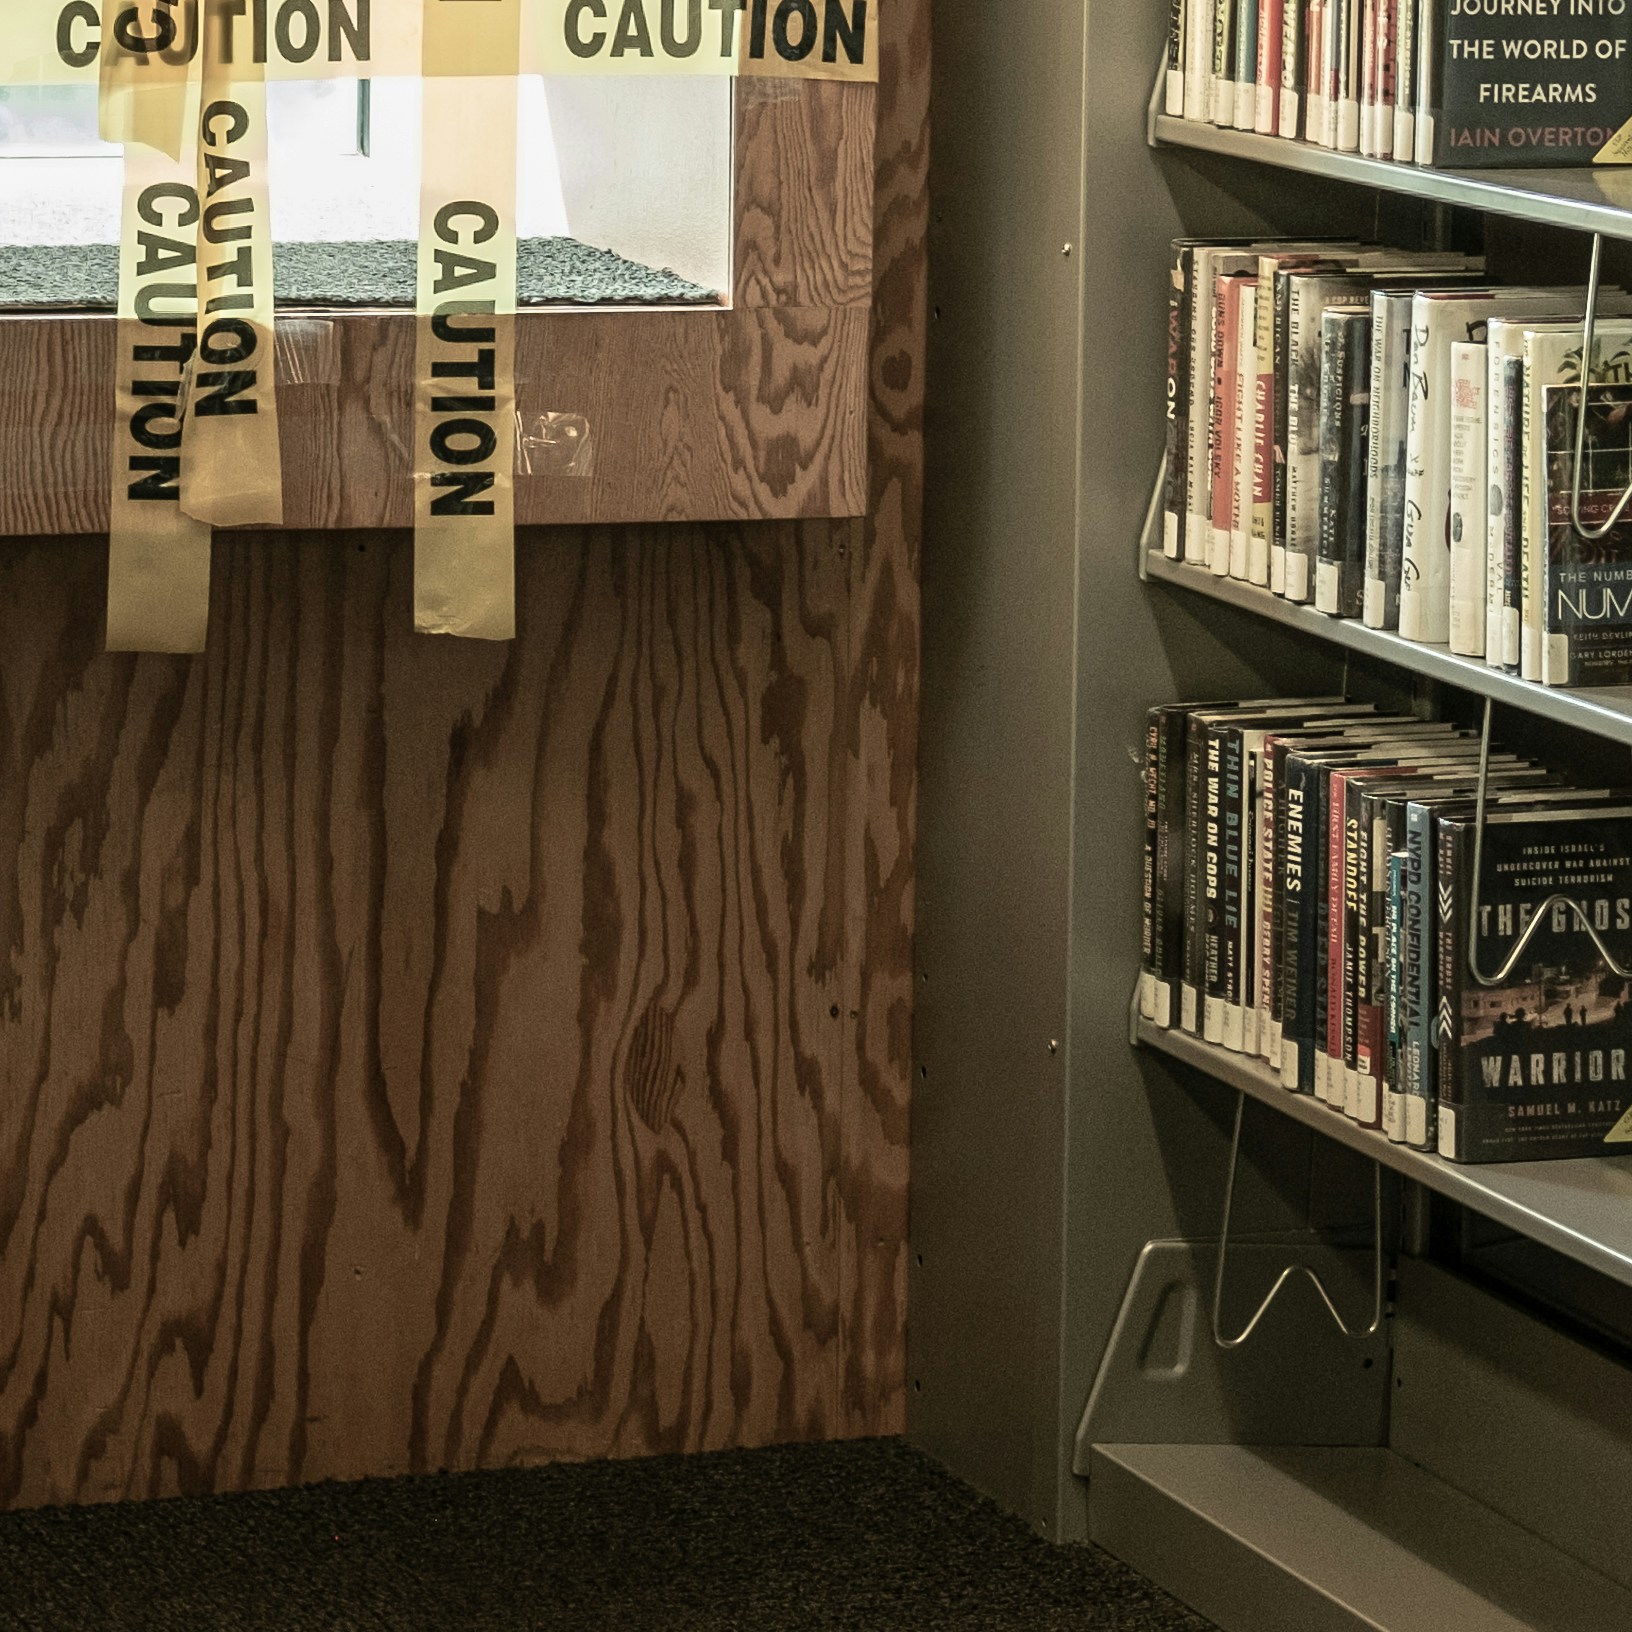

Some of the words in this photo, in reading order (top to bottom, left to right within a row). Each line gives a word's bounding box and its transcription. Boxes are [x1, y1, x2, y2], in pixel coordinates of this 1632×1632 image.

[1449, 40, 1497, 60] THE
[1502, 40, 1588, 60] WORLD
[1595, 40, 1626, 60] OF
[1479, 84, 1597, 103] FIREARMS
[1450, 128, 1499, 149] IAIN
[194, 100, 257, 416] CAUTION
[128, 182, 199, 501] CAUTION
[429, 200, 499, 516] CAUTION
[1560, 571, 1588, 583] THE
[1286, 788, 1304, 893] ENEMIES
[1480, 904, 1530, 936] THE
